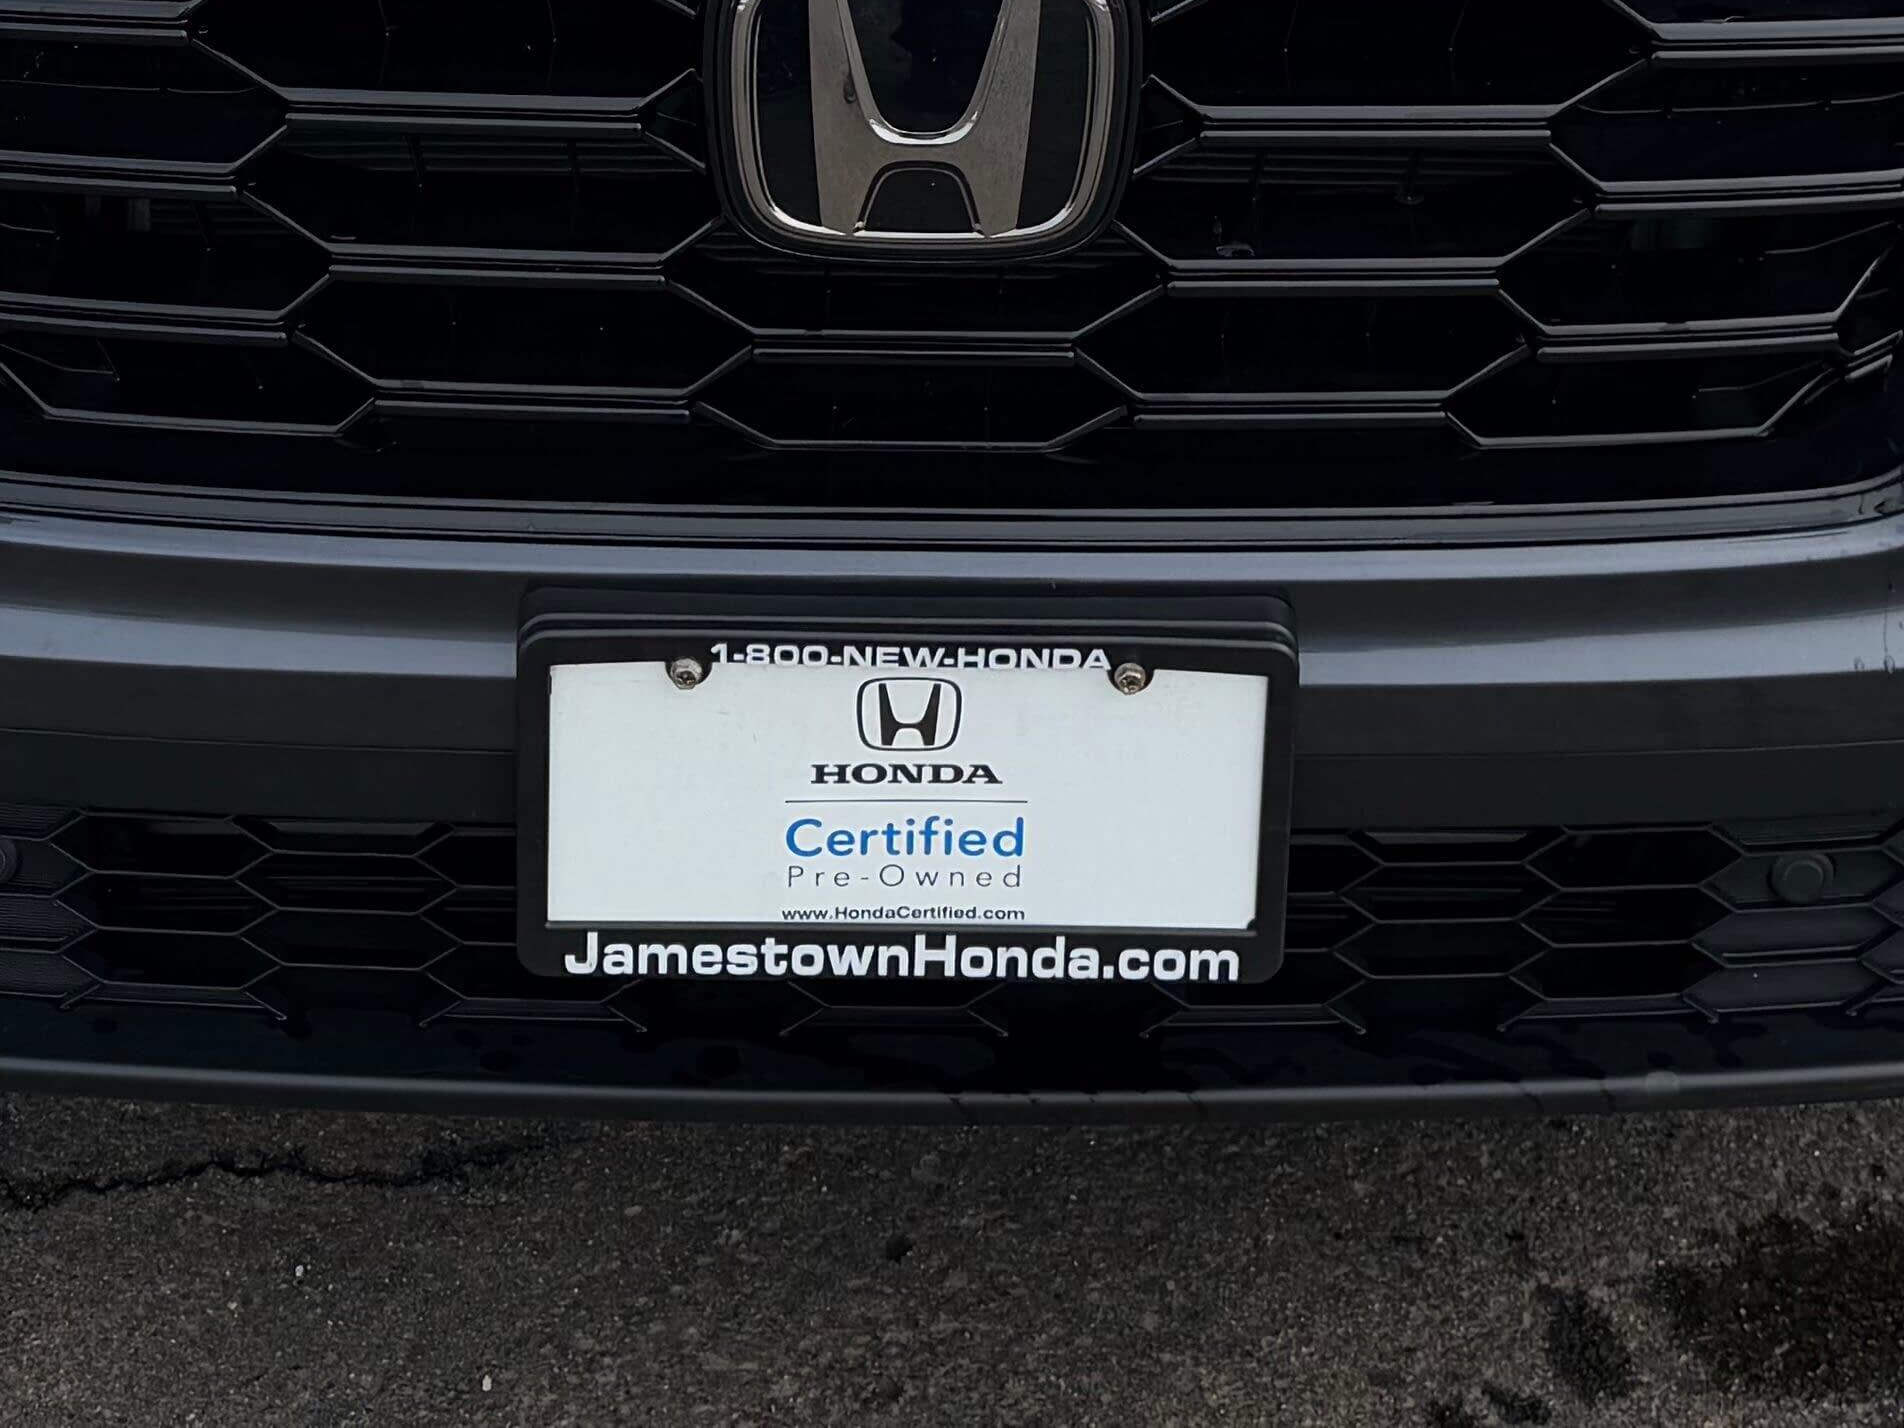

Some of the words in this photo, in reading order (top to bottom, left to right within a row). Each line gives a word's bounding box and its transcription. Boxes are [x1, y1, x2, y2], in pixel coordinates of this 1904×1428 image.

[709, 642, 1112, 671] 1-800-NEW-HONDA
[810, 763, 1003, 785] HONDA
[785, 815, 1025, 858] Certified
[787, 863, 1022, 889] Pre-Owned
[781, 905, 1026, 921] www.HondaCertified.com
[564, 930, 1241, 982] JamestownHonda.com
